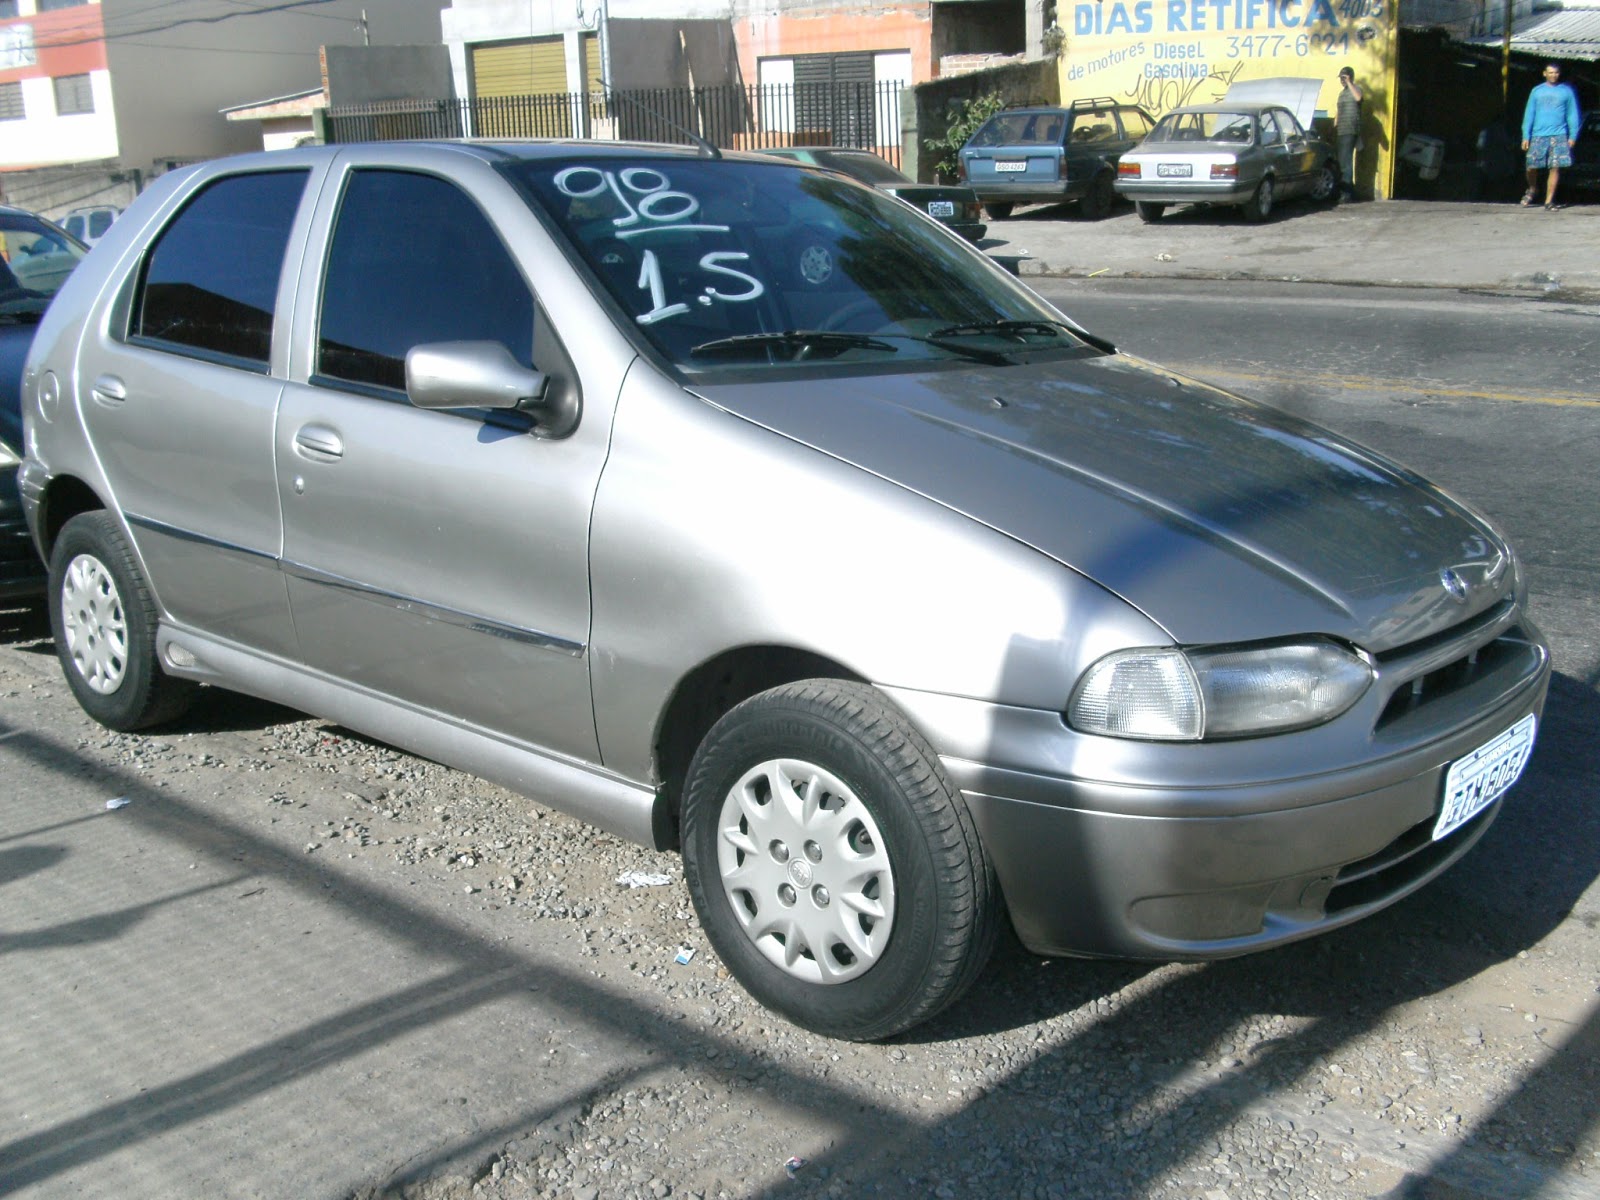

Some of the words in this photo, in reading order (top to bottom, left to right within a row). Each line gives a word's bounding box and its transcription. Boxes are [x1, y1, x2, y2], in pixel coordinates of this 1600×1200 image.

[1074, 1, 1153, 35] DIAS
[1167, 0, 1340, 32] RETIFICA
[1067, 65, 1084, 81] de
[1087, 41, 1145, 75] motores
[553, 167, 699, 226] 98
[636, 250, 765, 325] 1.5
